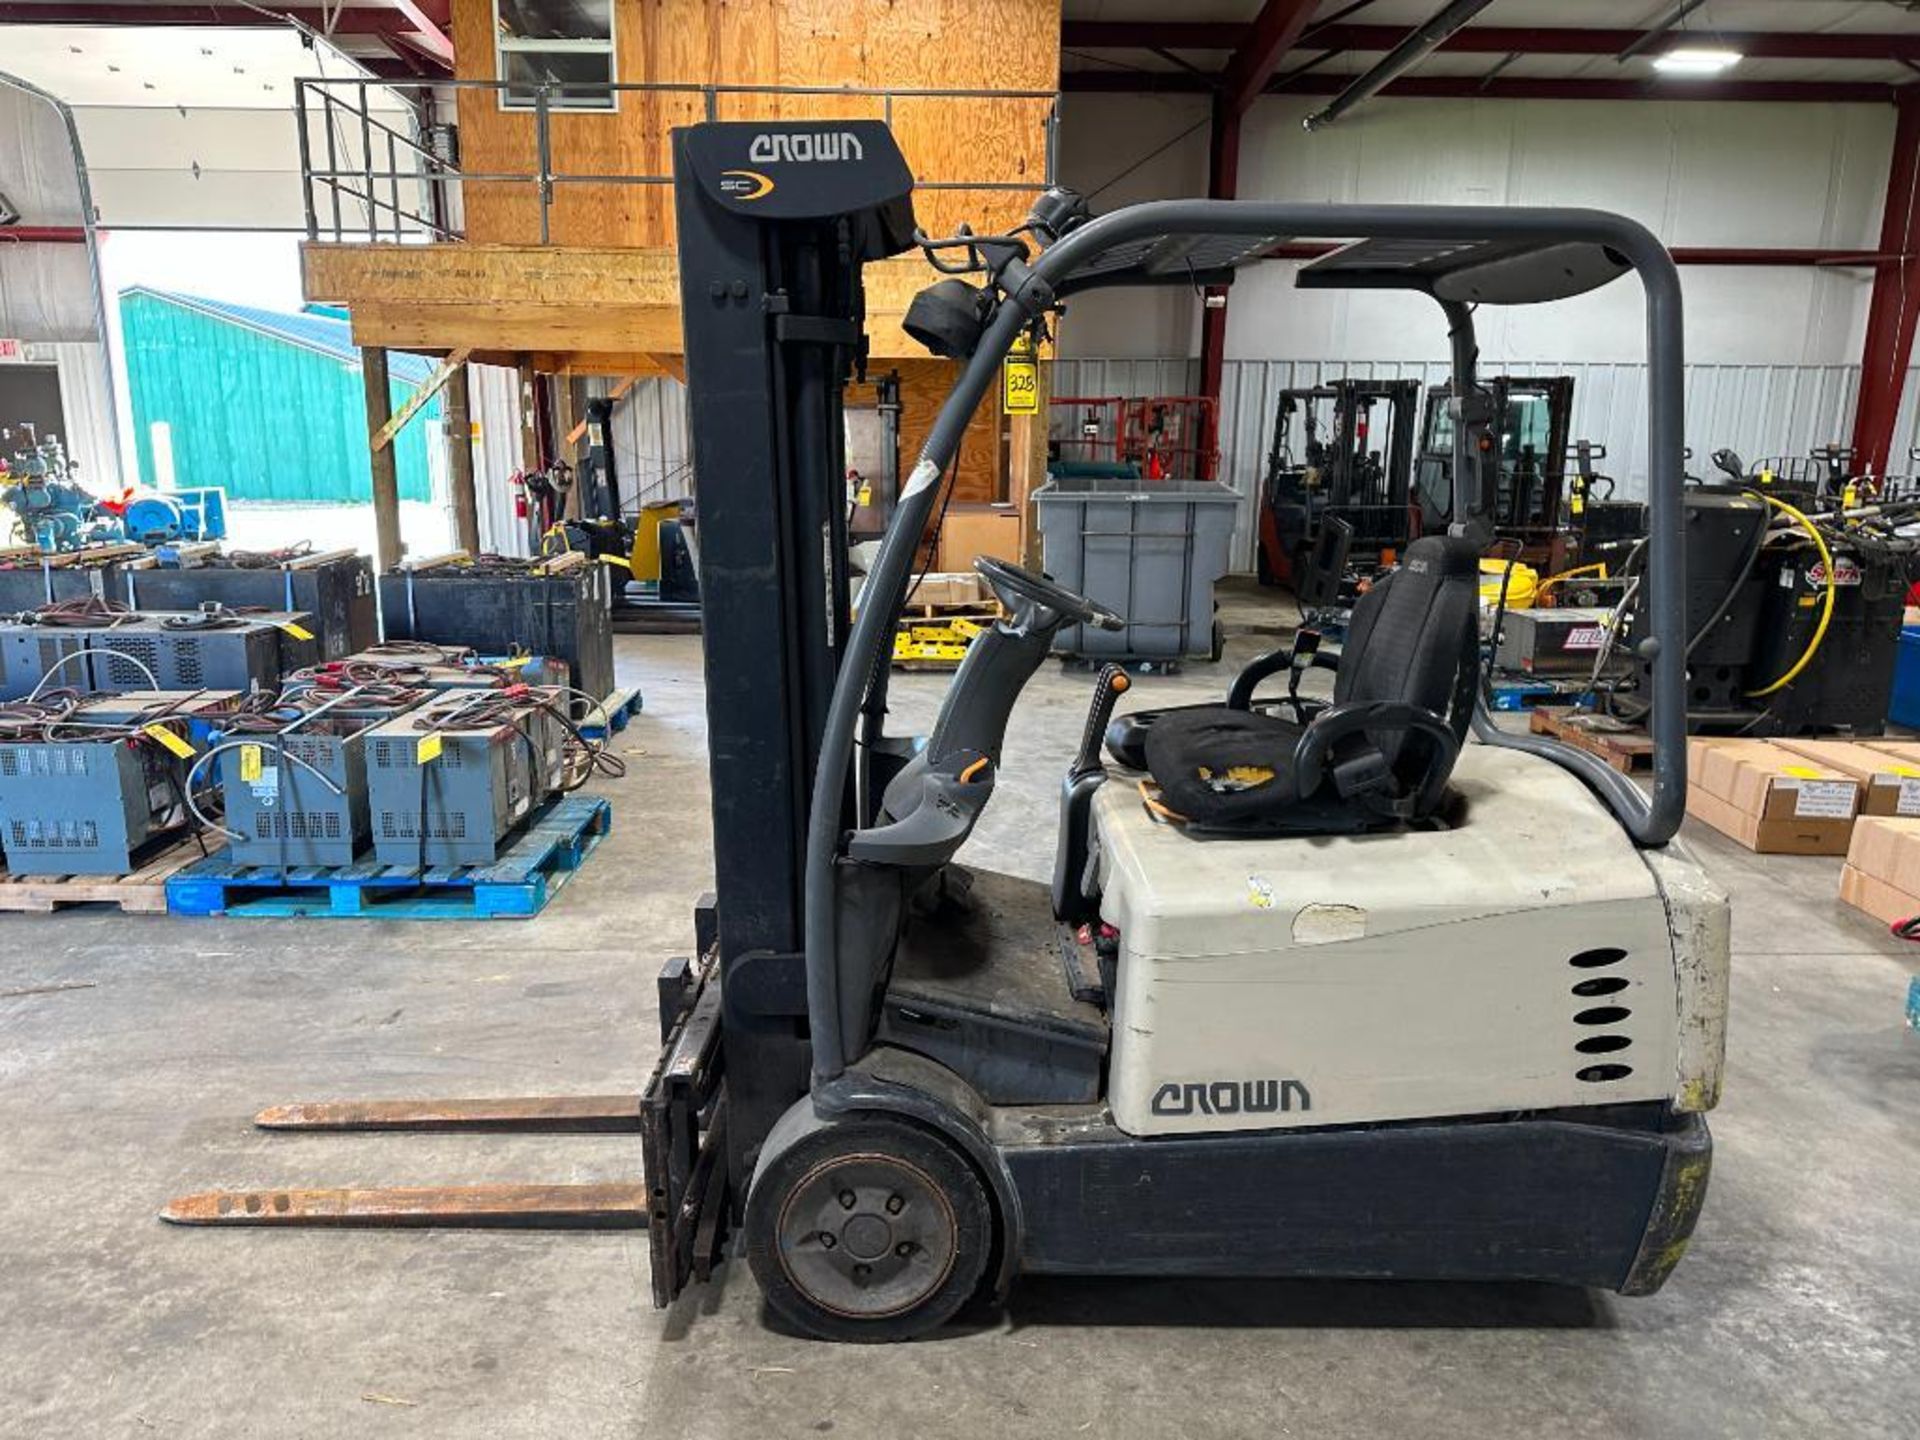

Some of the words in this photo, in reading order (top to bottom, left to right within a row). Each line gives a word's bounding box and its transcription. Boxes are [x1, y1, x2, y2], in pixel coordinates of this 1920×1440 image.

[750, 133, 863, 162] CROWN
[1811, 563, 1859, 581] Sark
[1151, 1080, 1311, 1116] CROWN
